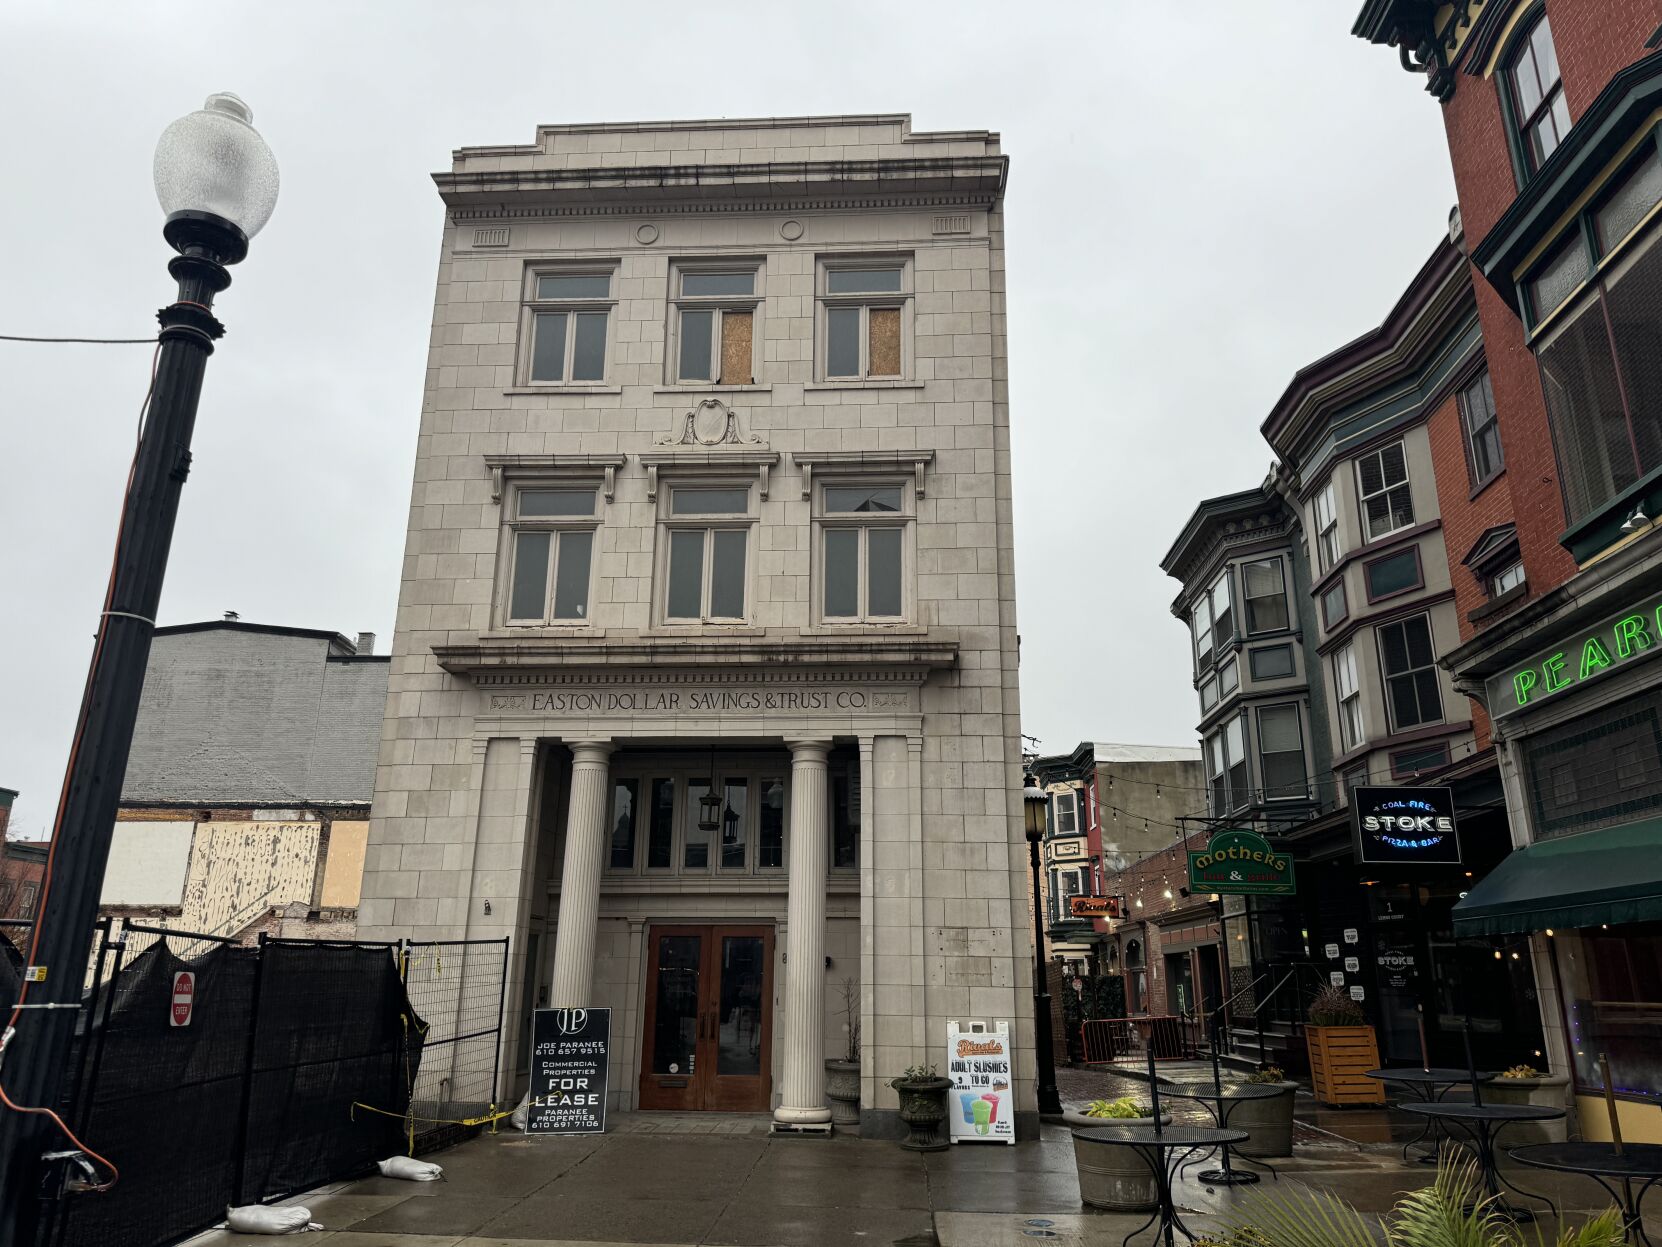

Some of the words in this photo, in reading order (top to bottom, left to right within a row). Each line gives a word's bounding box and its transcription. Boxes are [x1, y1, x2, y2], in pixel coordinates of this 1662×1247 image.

[1513, 605, 1662, 705] PEAR
[532, 693, 602, 710] EASTON
[608, 693, 680, 710] DOLLAR
[689, 692, 761, 709] SAVINGS
[836, 691, 867, 708] CO.
[1382, 800, 1405, 810] COAL
[1409, 800, 1432, 811] FIRE
[1362, 815, 1453, 832] STOKE
[1382, 835, 1408, 848] PIZZA
[1411, 840, 1418, 848] &
[1421, 836, 1439, 848] BAR
[1229, 870, 1244, 881] &
[559, 1008, 586, 1036] JP
[560, 1041, 604, 1049] PARANEE
[535, 1048, 555, 1056] 610
[580, 1047, 606, 1055] 9515
[951, 1060, 972, 1073] ADULT
[973, 1060, 1008, 1074] SLUSHIES
[548, 1078, 588, 1090] FOR
[970, 1074, 980, 1085] TO
[980, 1074, 990, 1085] GO
[535, 1093, 600, 1107] LEASE
[545, 1108, 588, 1116] PARANEE
[536, 1114, 595, 1122] PROPERTIES
[574, 1120, 599, 1128] 7106
